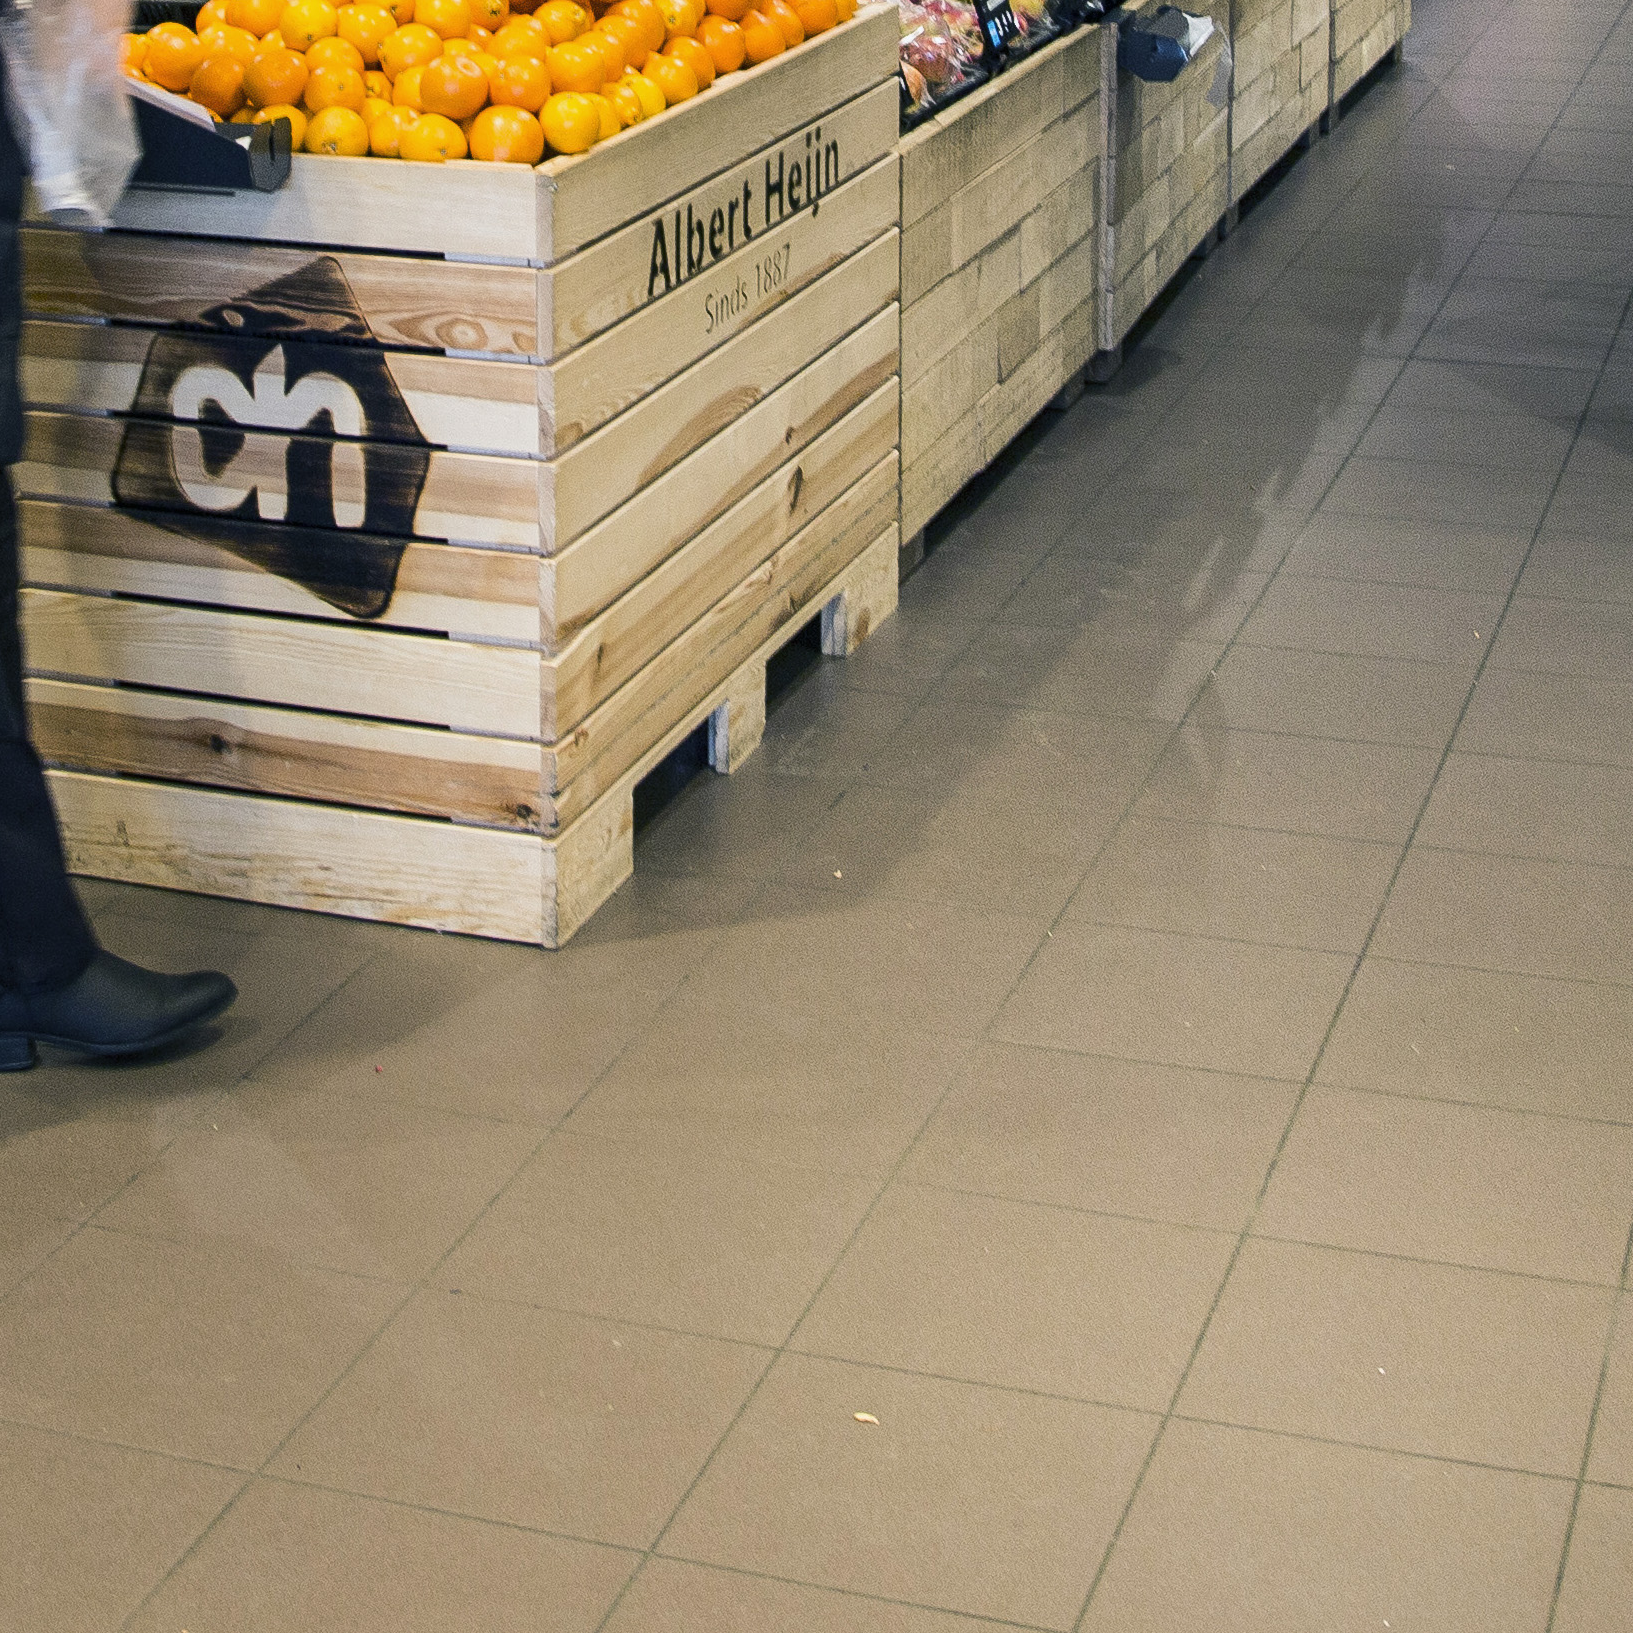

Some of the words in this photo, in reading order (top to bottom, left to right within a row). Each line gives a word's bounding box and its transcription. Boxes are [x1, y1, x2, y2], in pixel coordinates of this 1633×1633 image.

[648, 179, 752, 299] Albert
[765, 126, 839, 225] Heijn
[705, 275, 747, 334] Sinds
[755, 242, 791, 299] 1887
